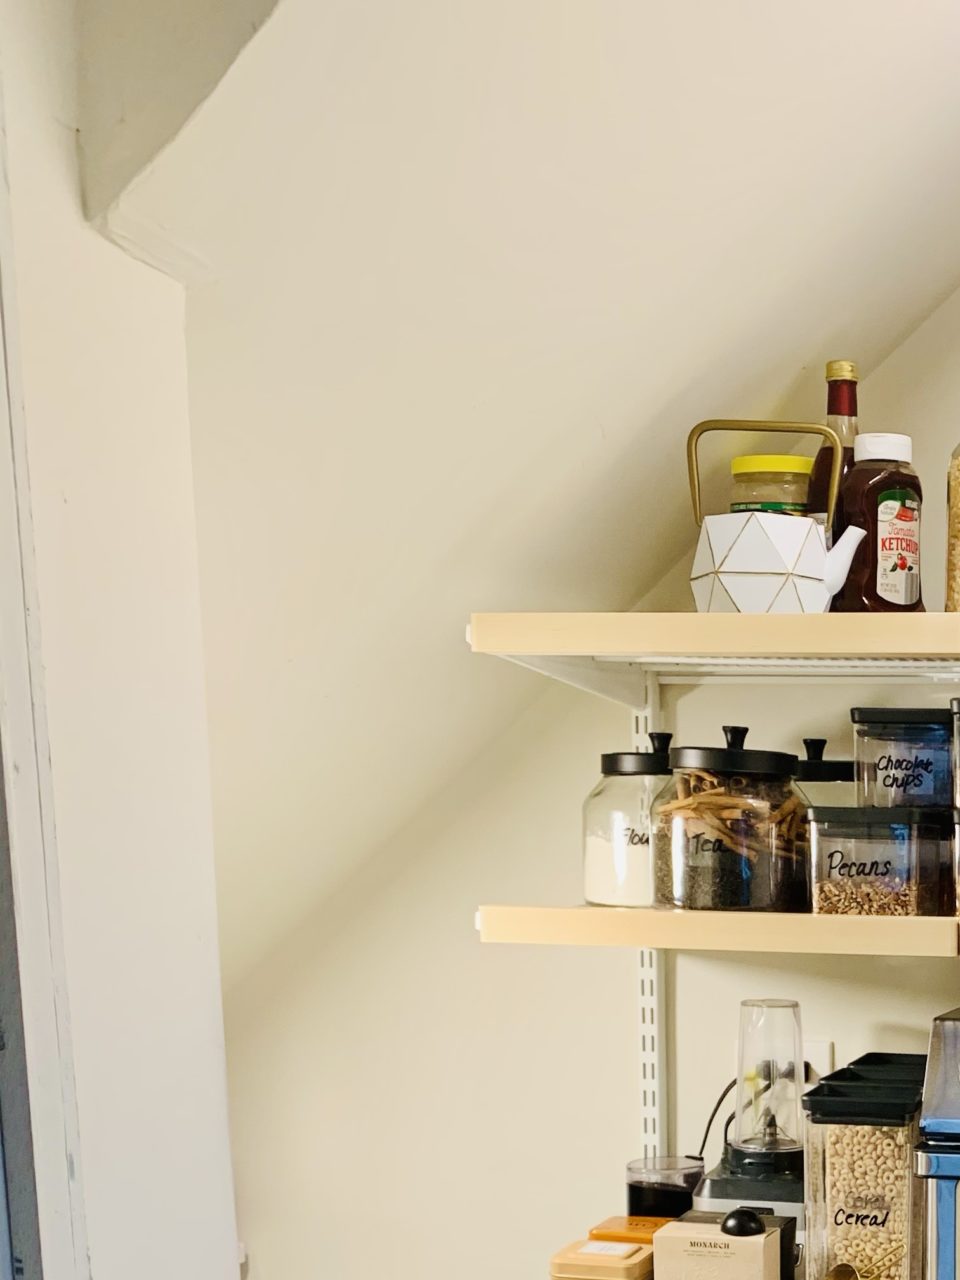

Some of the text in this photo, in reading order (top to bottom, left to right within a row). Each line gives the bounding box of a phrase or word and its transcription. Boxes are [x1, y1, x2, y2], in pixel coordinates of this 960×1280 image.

[881, 537, 919, 555] KETCHUP
[877, 755, 934, 774] Chocolate
[622, 827, 650, 846] Flou
[691, 831, 730, 855] Tea
[827, 850, 892, 878] Pecans
[833, 1208, 890, 1228] Cereal
[689, 1240, 730, 1249] MONARCH
